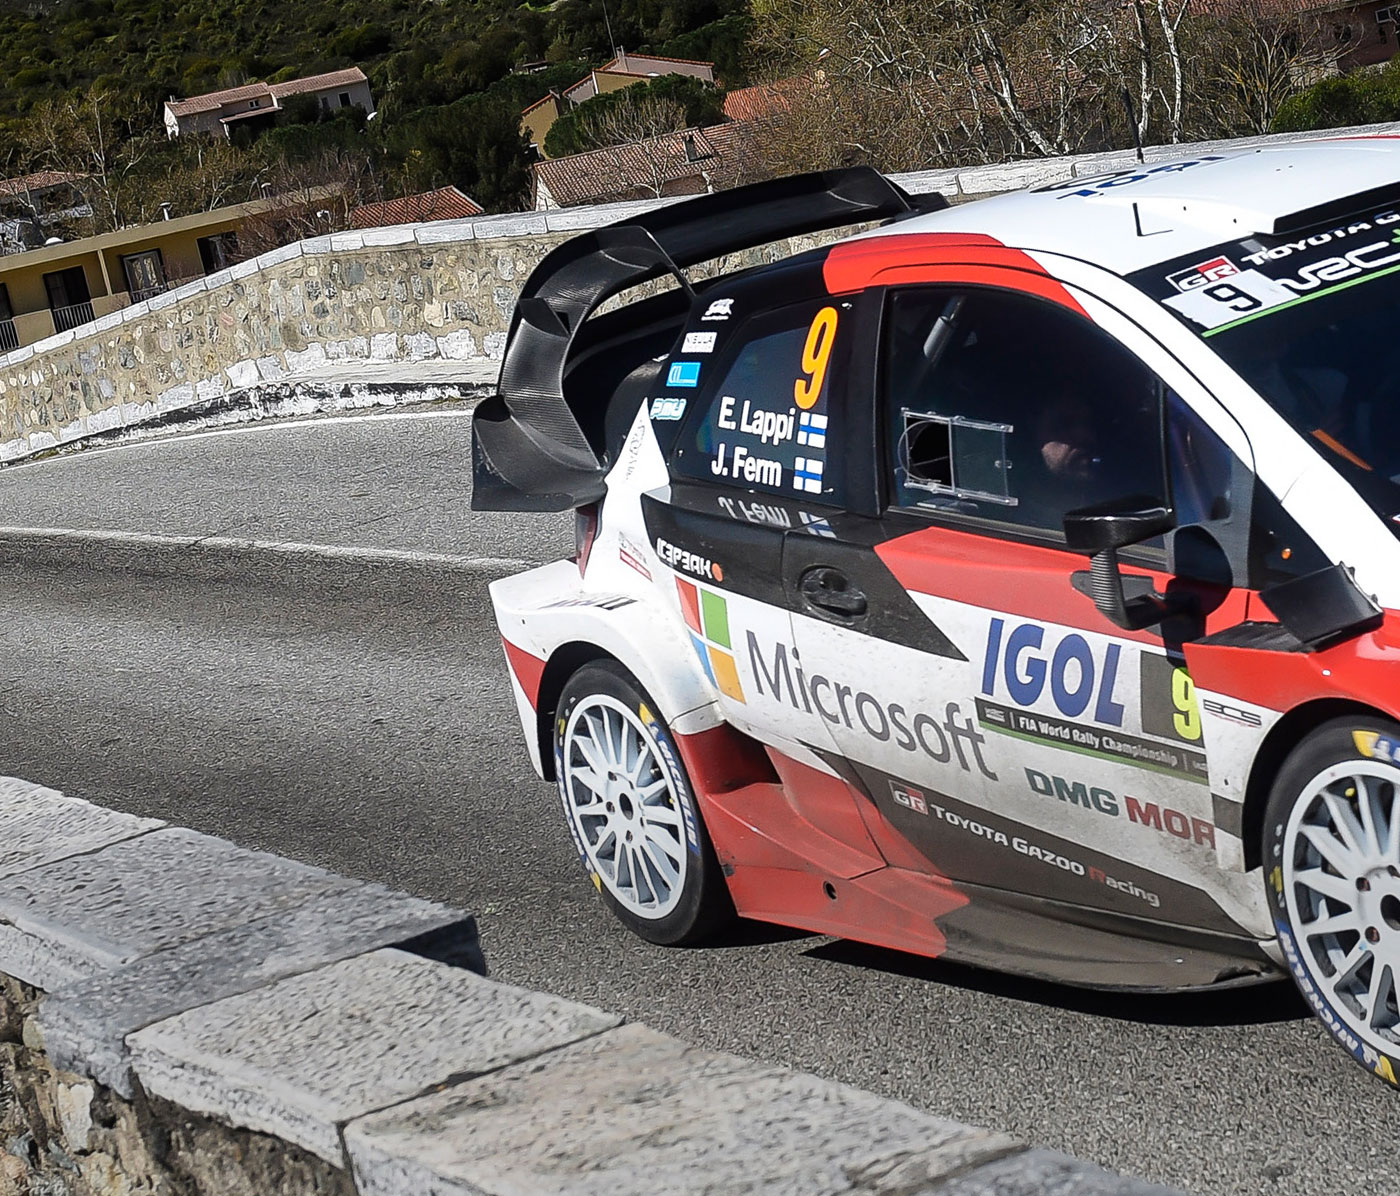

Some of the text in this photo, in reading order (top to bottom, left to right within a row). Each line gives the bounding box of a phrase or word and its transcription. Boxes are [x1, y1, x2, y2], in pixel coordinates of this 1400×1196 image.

[1177, 262, 1236, 292] GR
[1240, 221, 1372, 266] TOYOTA
[1202, 283, 1263, 313] 9
[794, 306, 838, 410] 9
[718, 396, 796, 446] E. Lappi
[711, 443, 782, 488] J. Ferm
[746, 629, 998, 781] Microsoft
[981, 617, 1125, 728] IGOL
[1172, 666, 1202, 741] 9
[1019, 717, 1037, 732] FIA
[1039, 721, 1070, 740] World
[1072, 730, 1100, 749] Rally
[1102, 736, 1178, 767] Championship
[1024, 767, 1217, 850] DMG MOR
[893, 789, 1160, 907] GR TOYOTA GAZOO Racing
